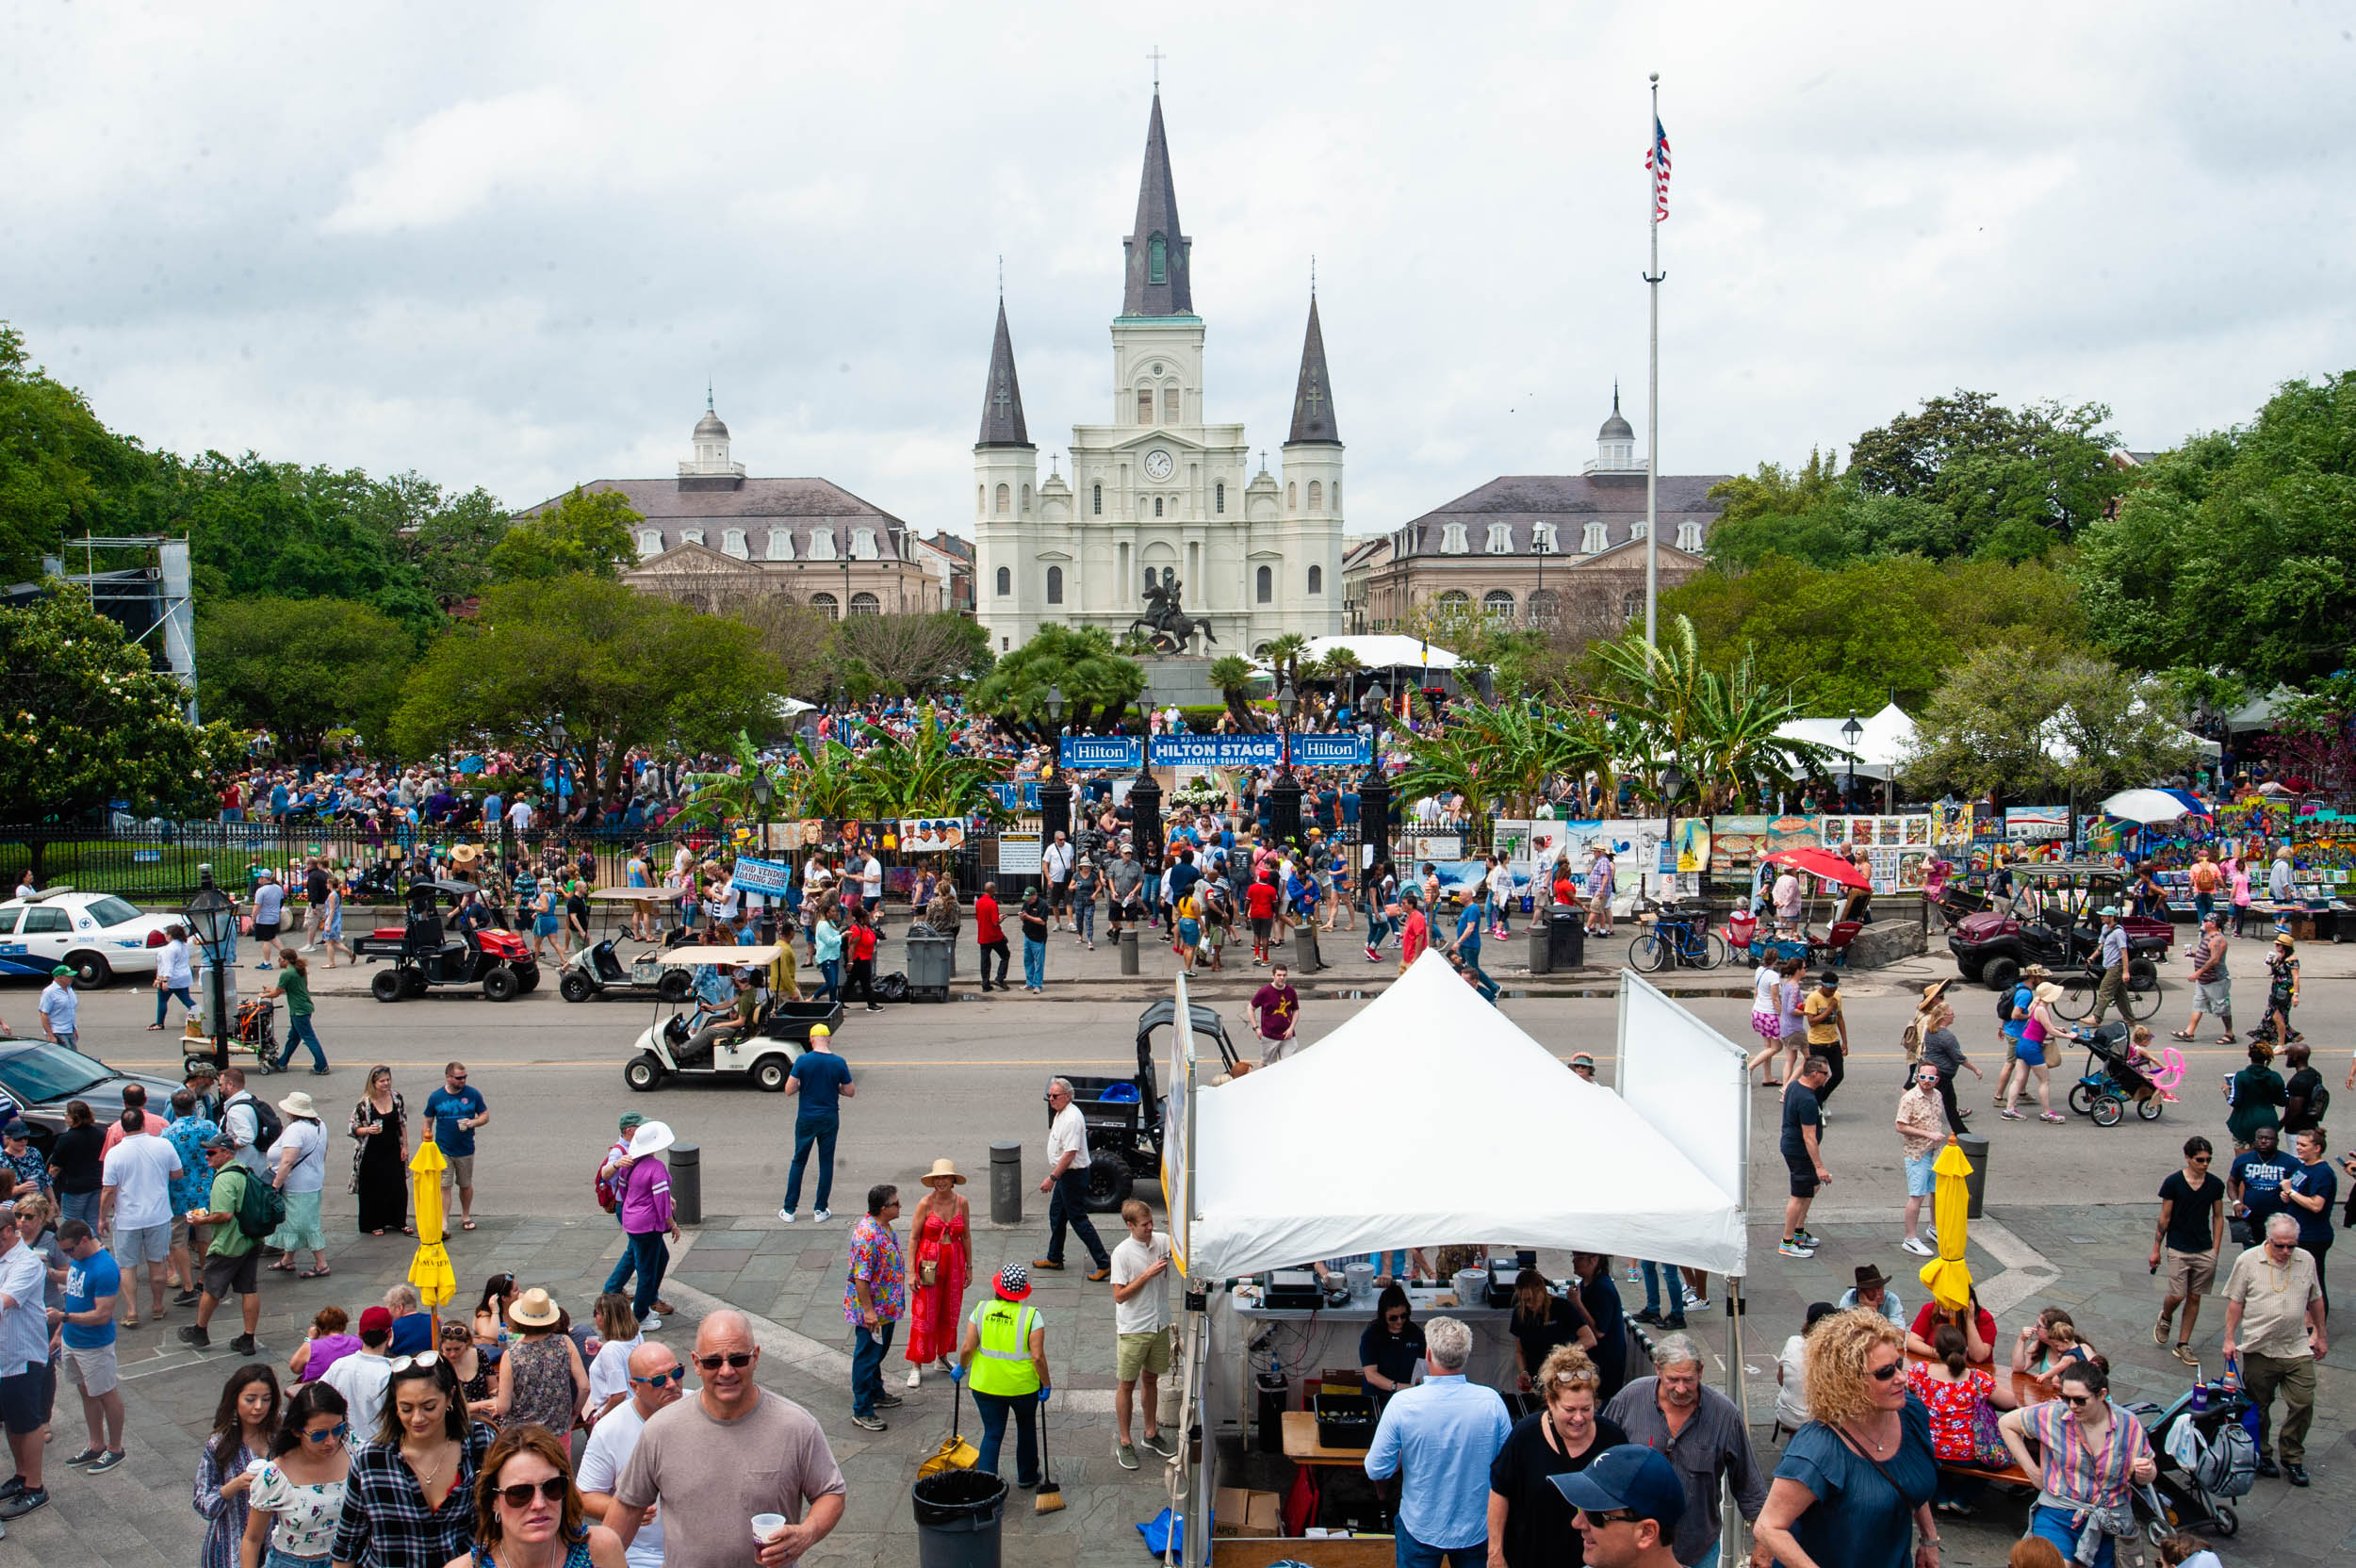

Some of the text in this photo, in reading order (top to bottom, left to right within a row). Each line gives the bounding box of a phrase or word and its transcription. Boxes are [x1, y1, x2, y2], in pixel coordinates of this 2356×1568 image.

[1078, 745, 1123, 759] Hilton
[1155, 744, 1276, 757] HILTON STAGE
[1307, 743, 1352, 756] Hilton
[738, 862, 757, 874] FOOD
[759, 867, 788, 879] VENDOR
[735, 871, 787, 888] LOADING ZONE
[2245, 1163, 2285, 1181] SPIRIT
[985, 1315, 1014, 1326] EMPIRE
